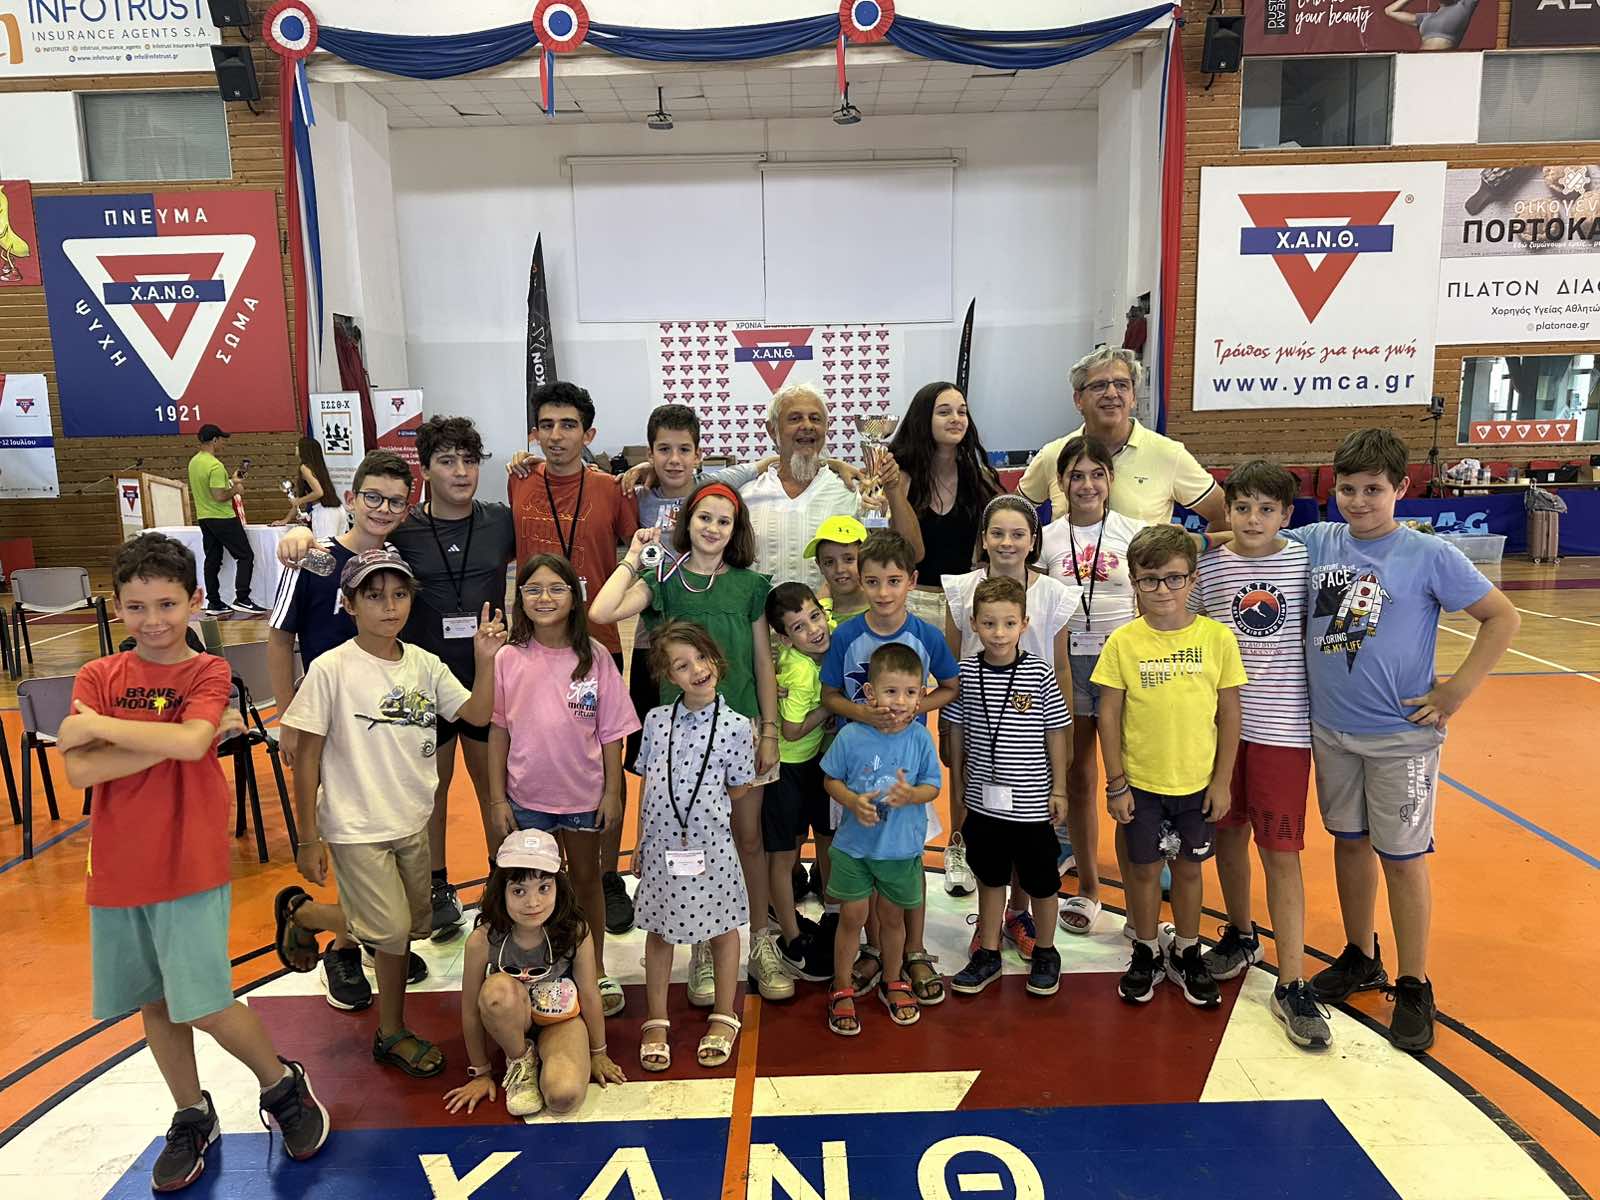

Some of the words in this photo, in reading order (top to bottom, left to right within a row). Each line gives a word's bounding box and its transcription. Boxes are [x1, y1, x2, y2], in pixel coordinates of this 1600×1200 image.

[28, 0, 202, 24] INFOTRUST
[1295, 10, 1326, 35] your
[1328, 4, 1375, 33] beauty
[32, 29, 115, 41] INSURANCE
[122, 28, 178, 39] AGENTS
[184, 27, 211, 38] S.A.
[104, 207, 208, 226] ΠΝΕΥΜΑ
[1276, 230, 1359, 249] Χ.Α.Ν.Θ.
[130, 285, 200, 301] Χ.Α.Ν.Θ.
[1491, 306, 1531, 316] Χορηγός
[1533, 304, 1563, 315] Υγείας
[75, 299, 128, 367] ΨΥΧΗ
[215, 296, 260, 365] ΣΩΜΑ
[736, 322, 763, 330] ΧΡΟΝΙΑ
[1535, 321, 1590, 332] platonae.gr
[752, 349, 795, 360] Χ.Α.Ν.Θ.
[1212, 373, 1415, 396] www.ymca.gr
[155, 405, 201, 422] 1921
[1312, 569, 1352, 590] SPACE
[1313, 632, 1347, 646] EXPLORING
[1332, 643, 1343, 653] MY
[1346, 640, 1362, 651] LIFE
[126, 687, 177, 698] BRAVE
